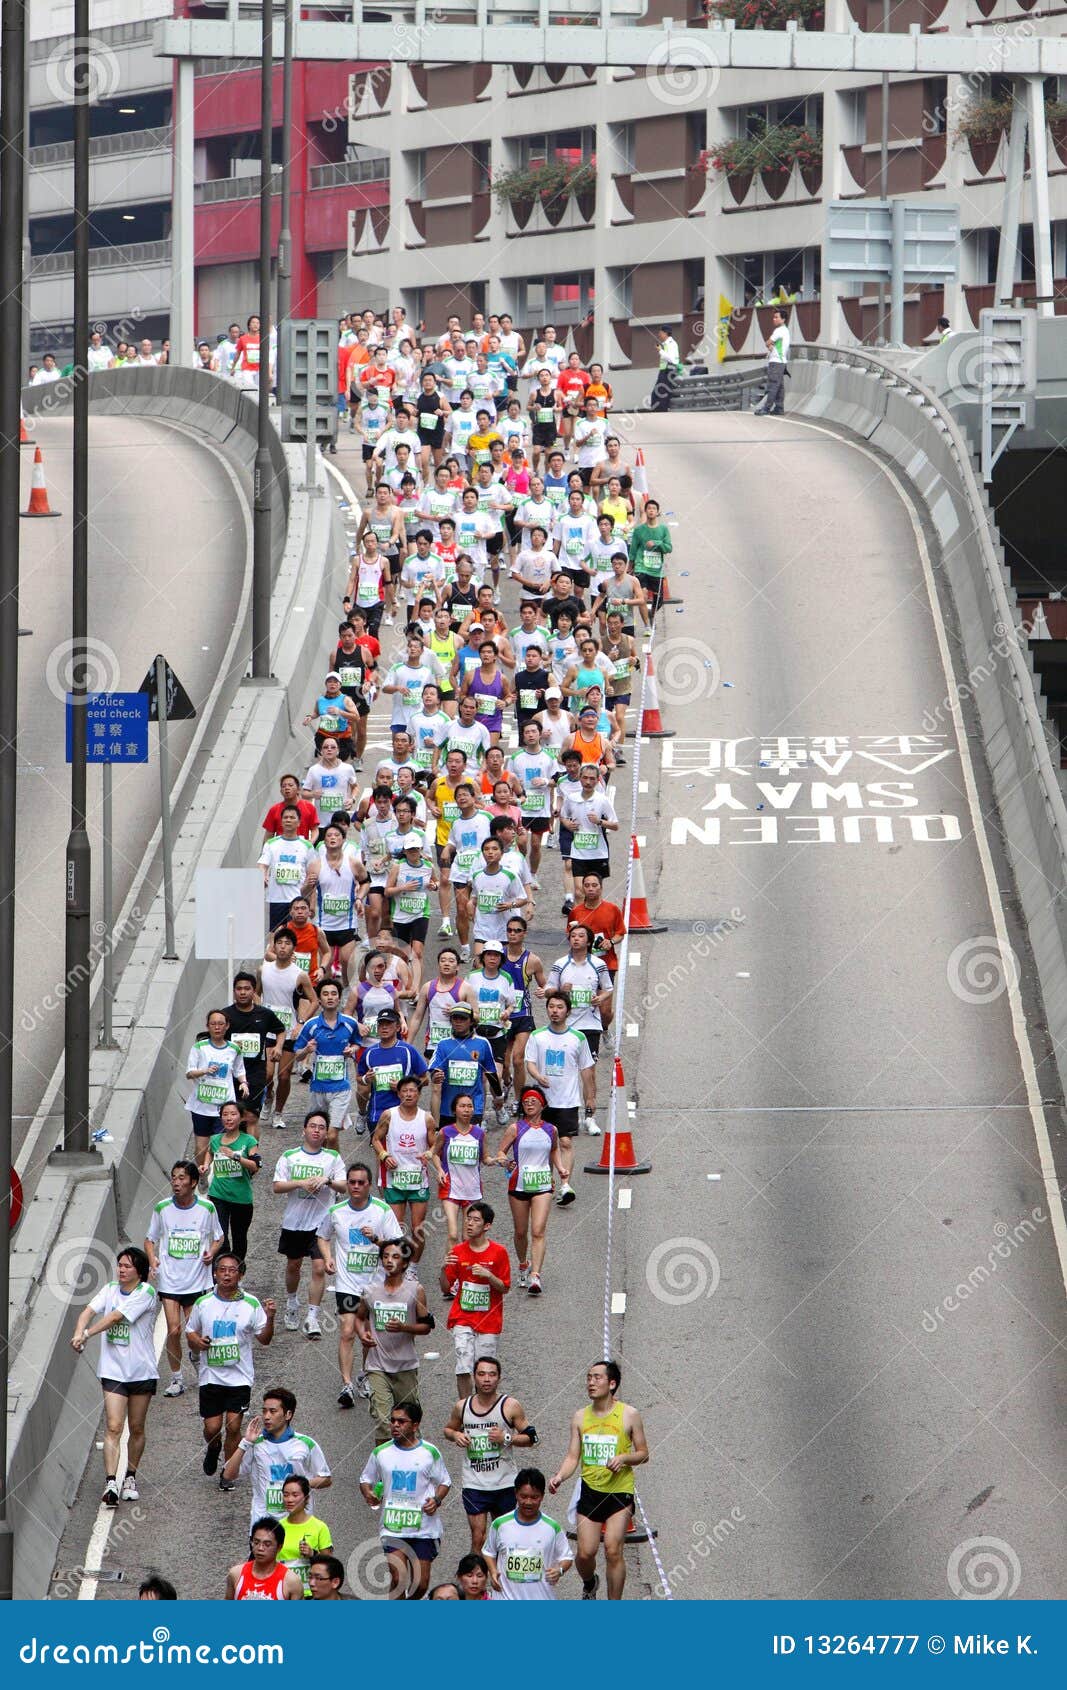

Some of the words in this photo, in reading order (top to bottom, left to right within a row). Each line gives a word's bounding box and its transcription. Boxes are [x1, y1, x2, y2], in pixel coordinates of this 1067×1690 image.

[92, 697, 125, 707] Police
[87, 709, 106, 719] eed
[110, 709, 141, 719] check
[93, 723, 123, 737] 警察
[86, 743, 138, 756] 度偵查
[701, 781, 919, 811] SWAY
[670, 814, 963, 846] QUEEN
[318, 1062, 344, 1075] M2862
[450, 1067, 477, 1081] M5483
[199, 1085, 227, 1099] W0044
[451, 1144, 479, 1158] W1601
[292, 1166, 322, 1179] M1552
[392, 1171, 422, 1185] M5377
[348, 1252, 379, 1266] M4765
[208, 1345, 239, 1360] M4198
[583, 1443, 615, 1459] M1398
[385, 1510, 421, 1527] M4197
[507, 1555, 542, 1572] 66254
